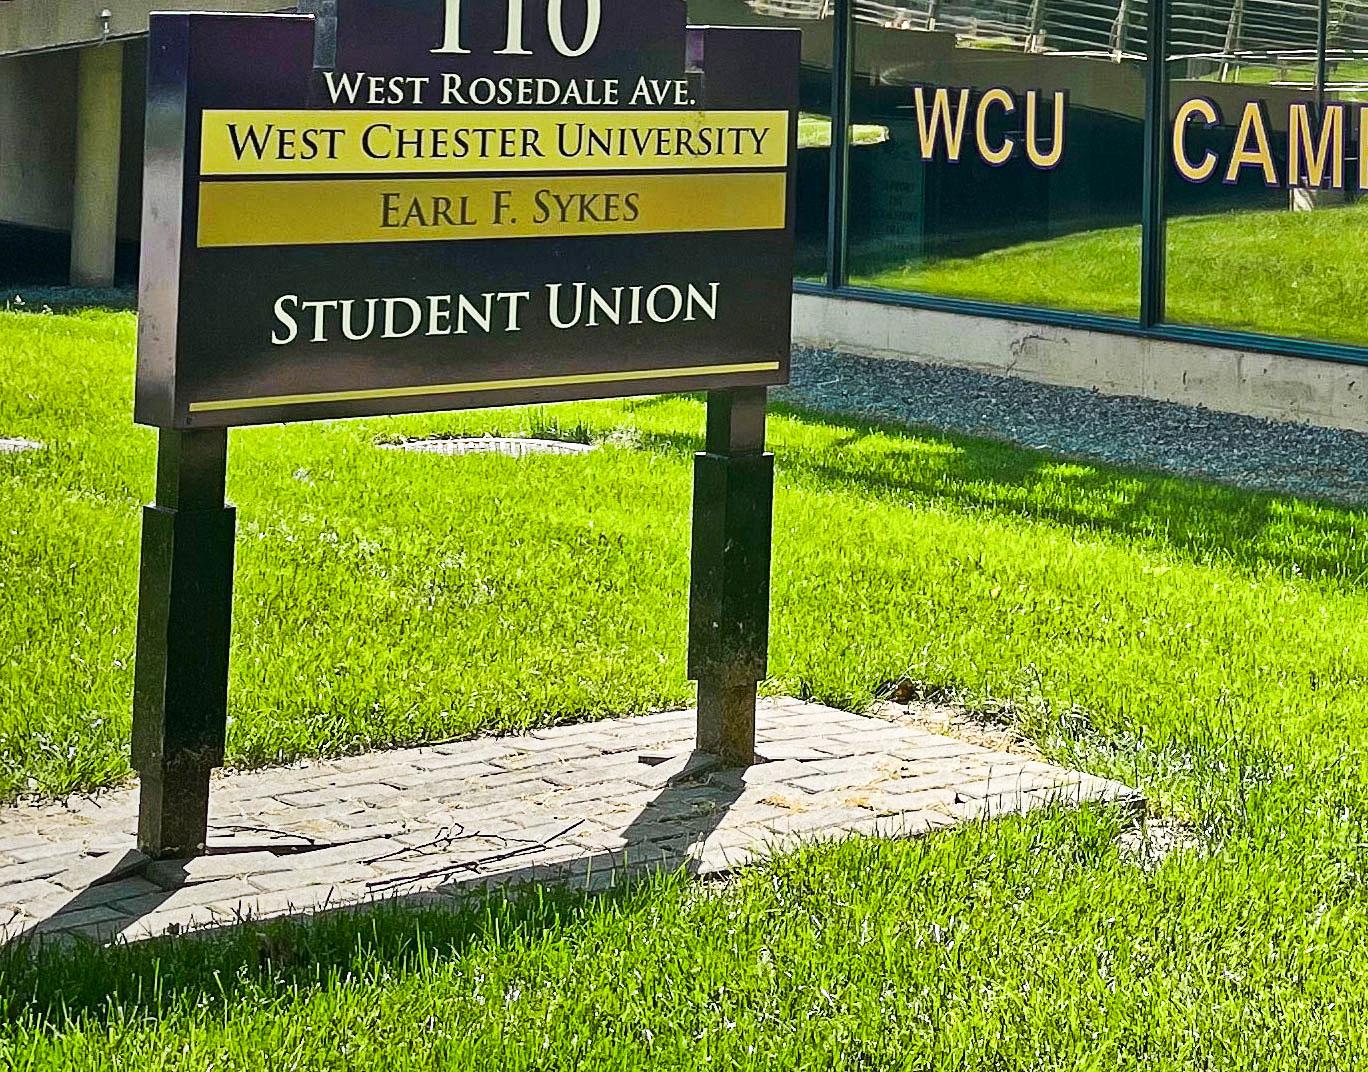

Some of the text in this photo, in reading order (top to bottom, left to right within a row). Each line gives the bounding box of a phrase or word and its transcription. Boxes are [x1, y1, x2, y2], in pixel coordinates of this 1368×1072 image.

[324, 72, 696, 106] WEST ROSEDALE AVE.
[227, 122, 770, 161] WEST CHESTER UNIVERSITY
[913, 85, 1069, 169] WCU
[379, 190, 640, 228] EARL F. SYKES
[270, 282, 721, 346] STUDENT UNION
